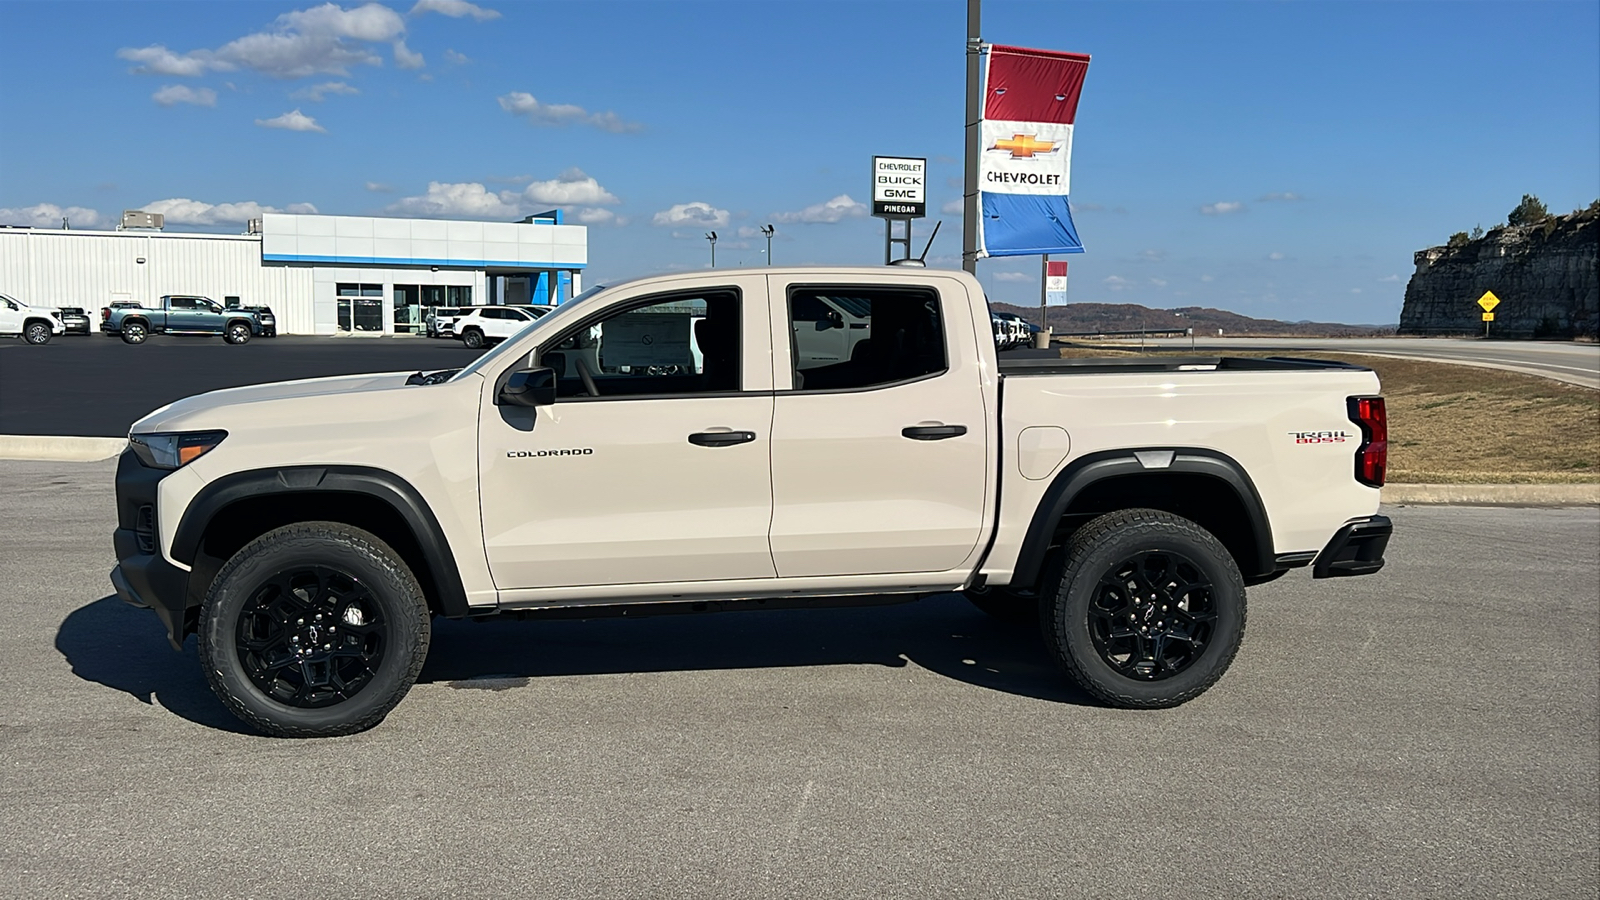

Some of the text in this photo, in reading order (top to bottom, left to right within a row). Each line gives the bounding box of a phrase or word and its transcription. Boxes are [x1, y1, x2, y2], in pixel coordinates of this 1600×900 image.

[879, 162, 922, 171] CHEVROLET
[878, 175, 922, 185] BUICK
[987, 171, 1060, 185] CHEVROLET
[884, 189, 916, 198] GMC
[884, 204, 916, 213] PINEGAR
[1288, 431, 1353, 439] TRAIL
[506, 448, 593, 458] COLORADO
